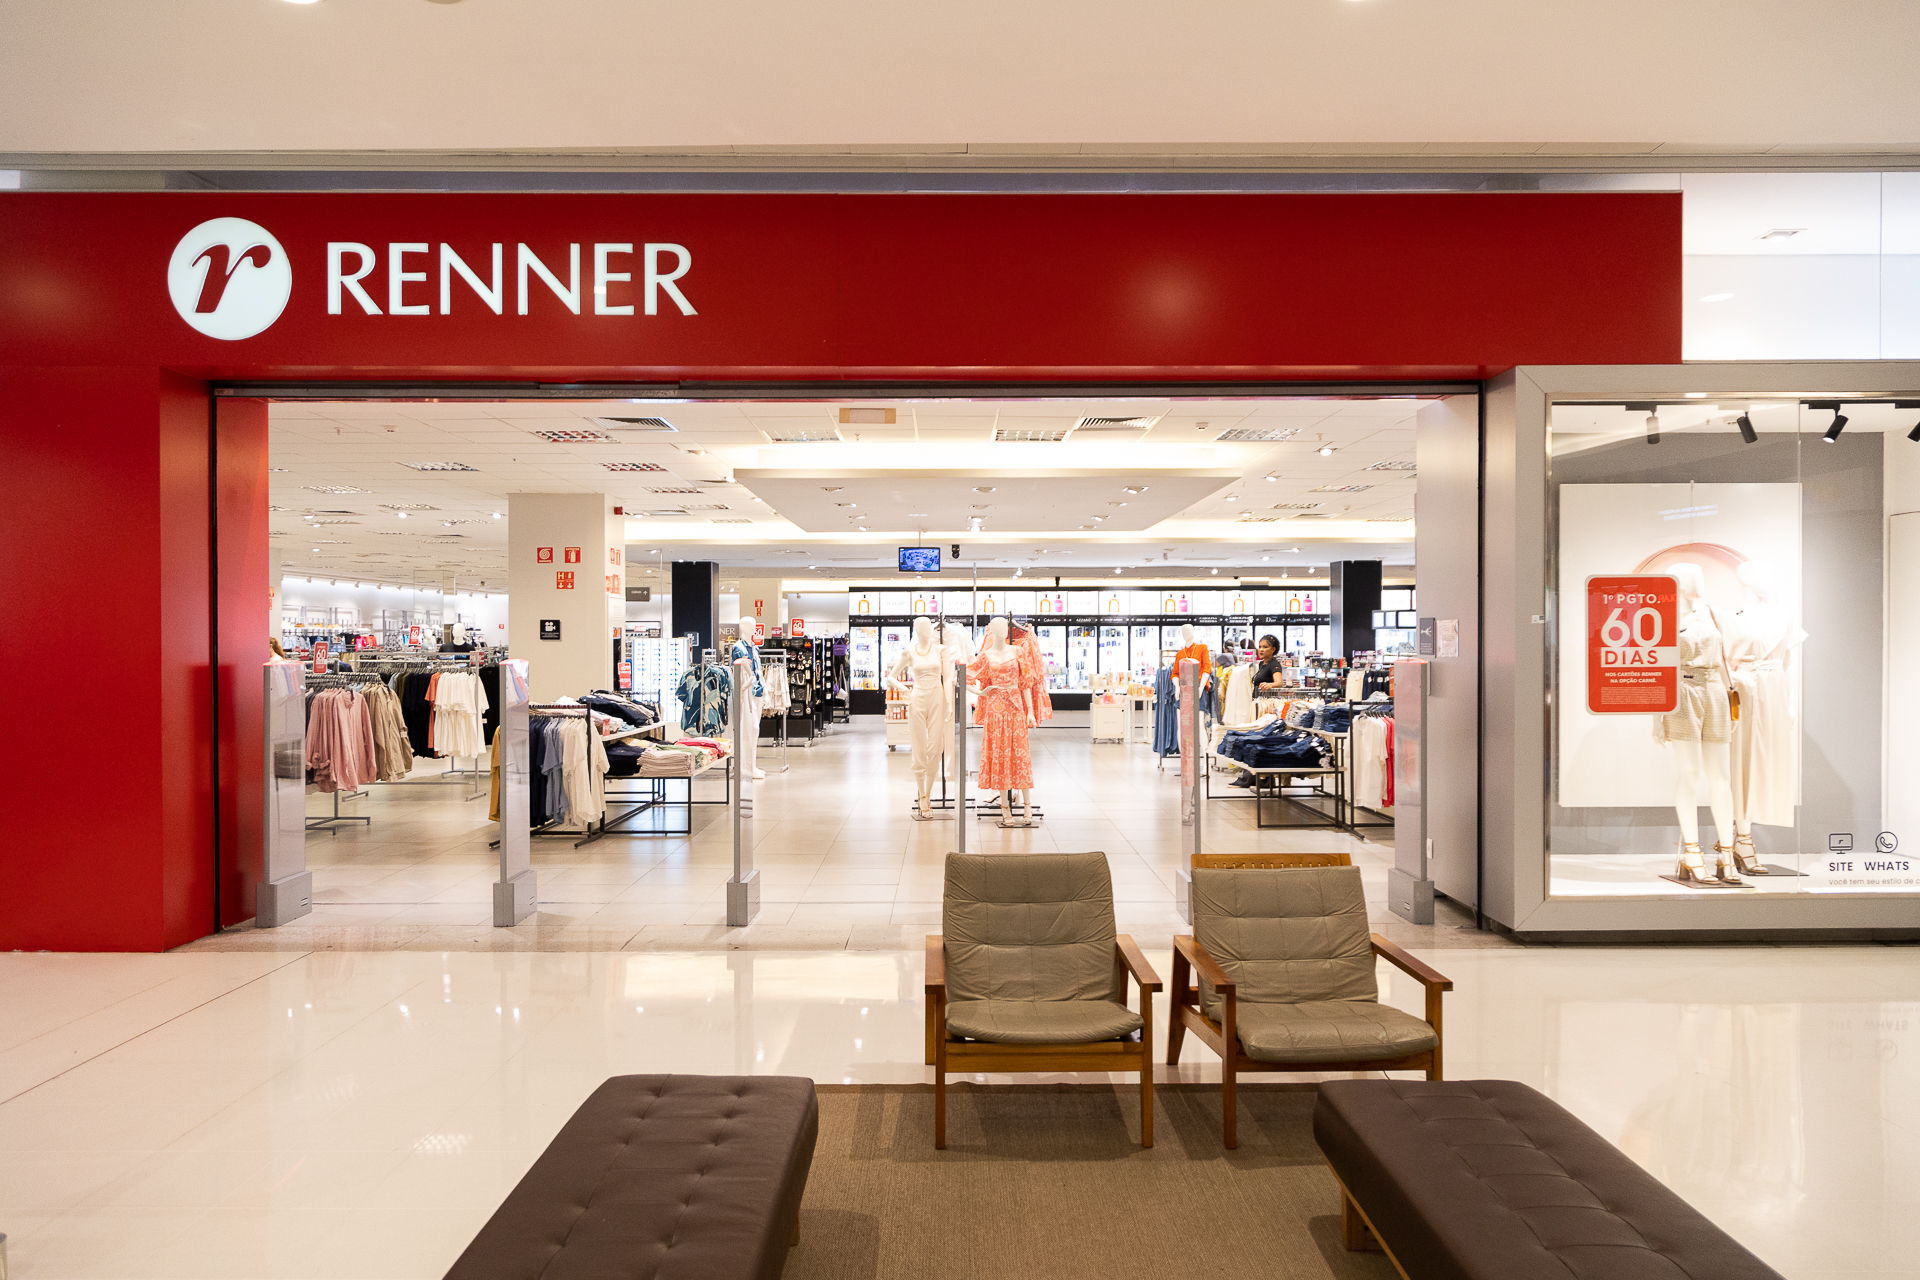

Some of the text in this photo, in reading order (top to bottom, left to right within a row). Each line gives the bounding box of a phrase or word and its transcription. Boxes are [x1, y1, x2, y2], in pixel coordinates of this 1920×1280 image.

[326, 241, 698, 317] RENNER
[1618, 594, 1661, 604] PGTO.
[719, 627, 735, 635] NER
[1601, 606, 1662, 648] 60
[1604, 650, 1659, 665] DIAS
[1829, 861, 1910, 872] SITE WHATS
